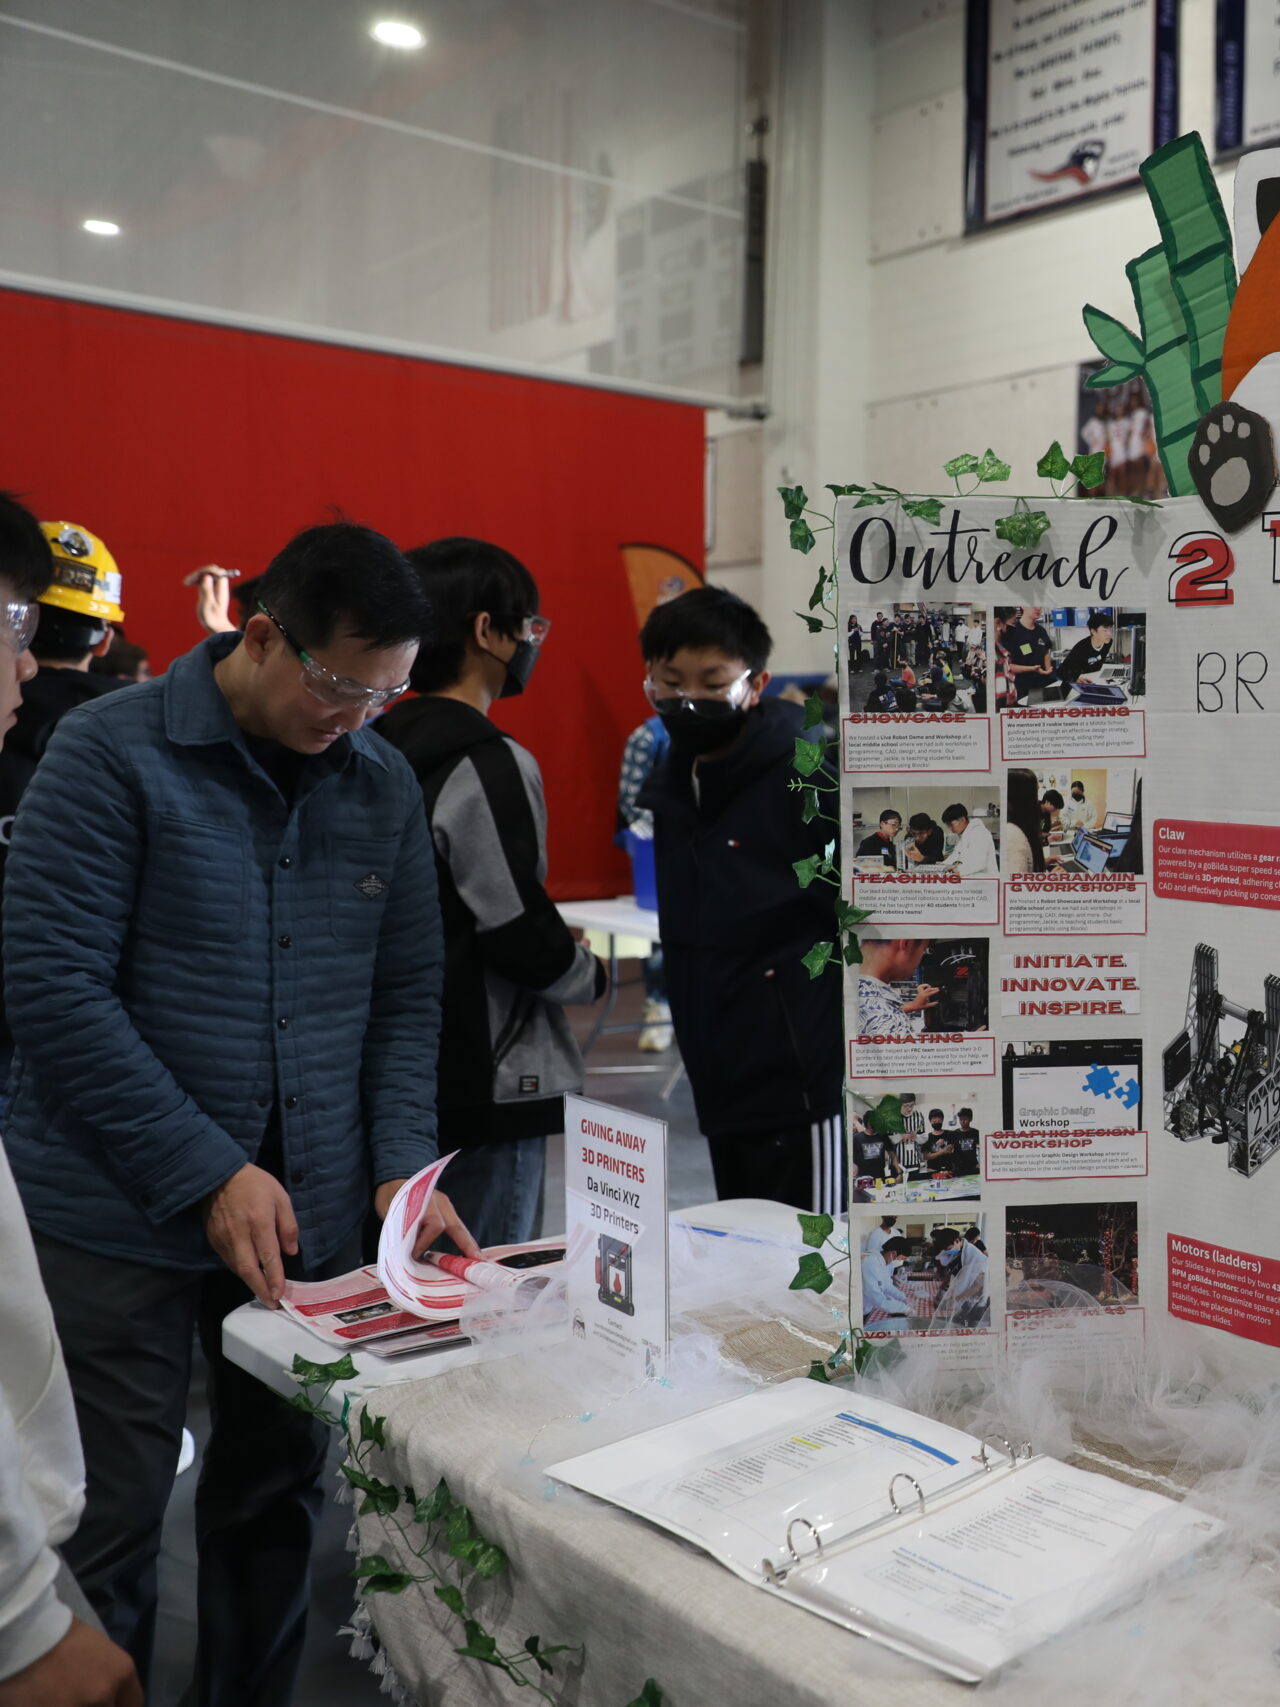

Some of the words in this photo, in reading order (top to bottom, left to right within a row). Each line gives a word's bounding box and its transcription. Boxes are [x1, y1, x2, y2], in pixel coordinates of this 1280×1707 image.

[850, 509, 1129, 600] Outreach
[850, 712, 967, 724] SHOWCASE
[1008, 706, 1130, 718] MENTORING
[1158, 827, 1185, 840] Claw
[856, 873, 962, 885] TEACHING
[1010, 872, 1135, 882] PROGRAMMIN
[1026, 882, 1137, 893] WORKSHOPS
[1013, 954, 1127, 969] INITIATE.
[1001, 977, 1140, 992] INNOVATE.
[1018, 1000, 1126, 1016] INSPIRE.
[857, 1033, 965, 1045] DONATING
[1019, 1106, 1060, 1118] Graphic
[1061, 1105, 1096, 1117] Design
[1019, 1117, 1071, 1129] Workshop
[581, 1118, 613, 1143] GIVING
[616, 1131, 646, 1153] AWAY
[992, 1138, 1093, 1150] WORKSHOP
[582, 1147, 594, 1164] 3D
[597, 1152, 645, 1184] PRINTERS
[587, 1176, 598, 1192] Da
[600, 1180, 621, 1202] Vinci
[623, 1188, 640, 1209] XYZ
[590, 1203, 602, 1219] 3D
[603, 1207, 639, 1234] Printers
[1171, 1240, 1210, 1258] Motors
[1212, 1250, 1261, 1273] (ladders)
